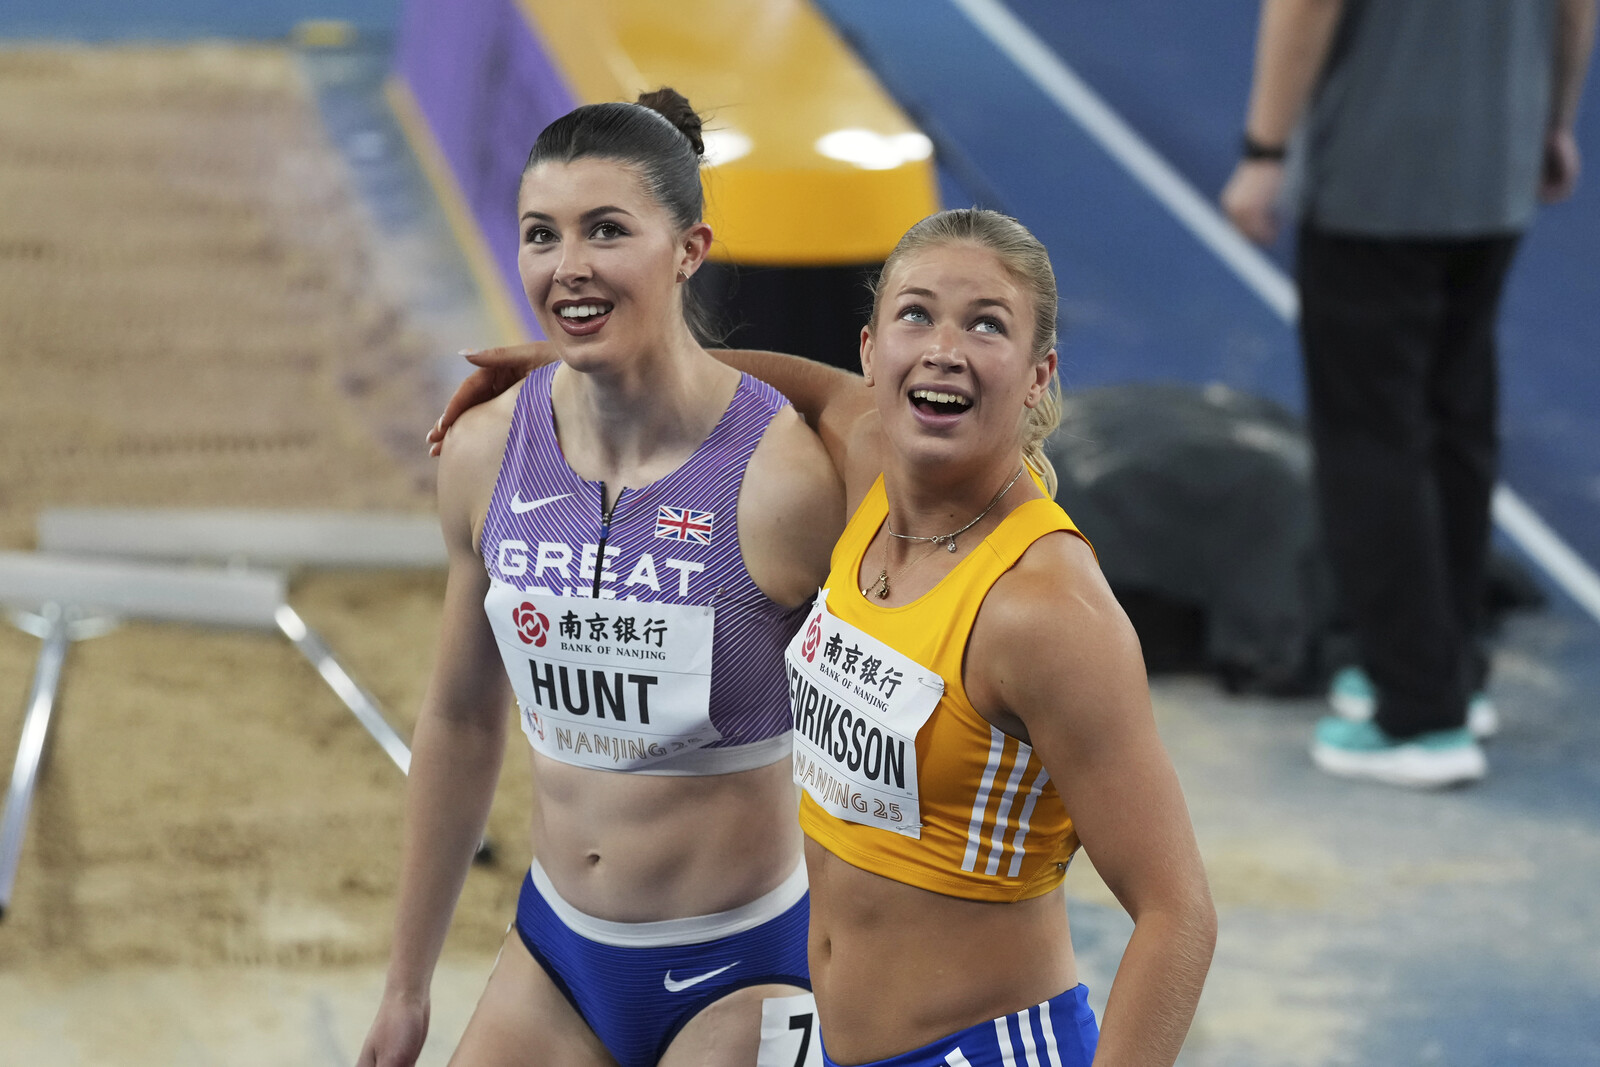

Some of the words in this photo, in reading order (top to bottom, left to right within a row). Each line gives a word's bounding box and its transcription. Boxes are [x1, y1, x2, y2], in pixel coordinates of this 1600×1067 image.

[498, 540, 705, 597] GREAT
[559, 609, 668, 648] 南京银行
[560, 642, 592, 654] BANK
[597, 645, 612, 655] OF
[616, 647, 667, 661] NANJING
[528, 658, 658, 725] HUNT
[819, 662, 841, 683] BANK
[841, 677, 853, 690] OF
[853, 685, 890, 713] NANJING
[823, 632, 904, 700] 南京银行
[555, 727, 667, 763] NANJING
[795, 750, 868, 813] NANJING
[873, 798, 903, 822] 25
[788, 1012, 814, 1067] 7
